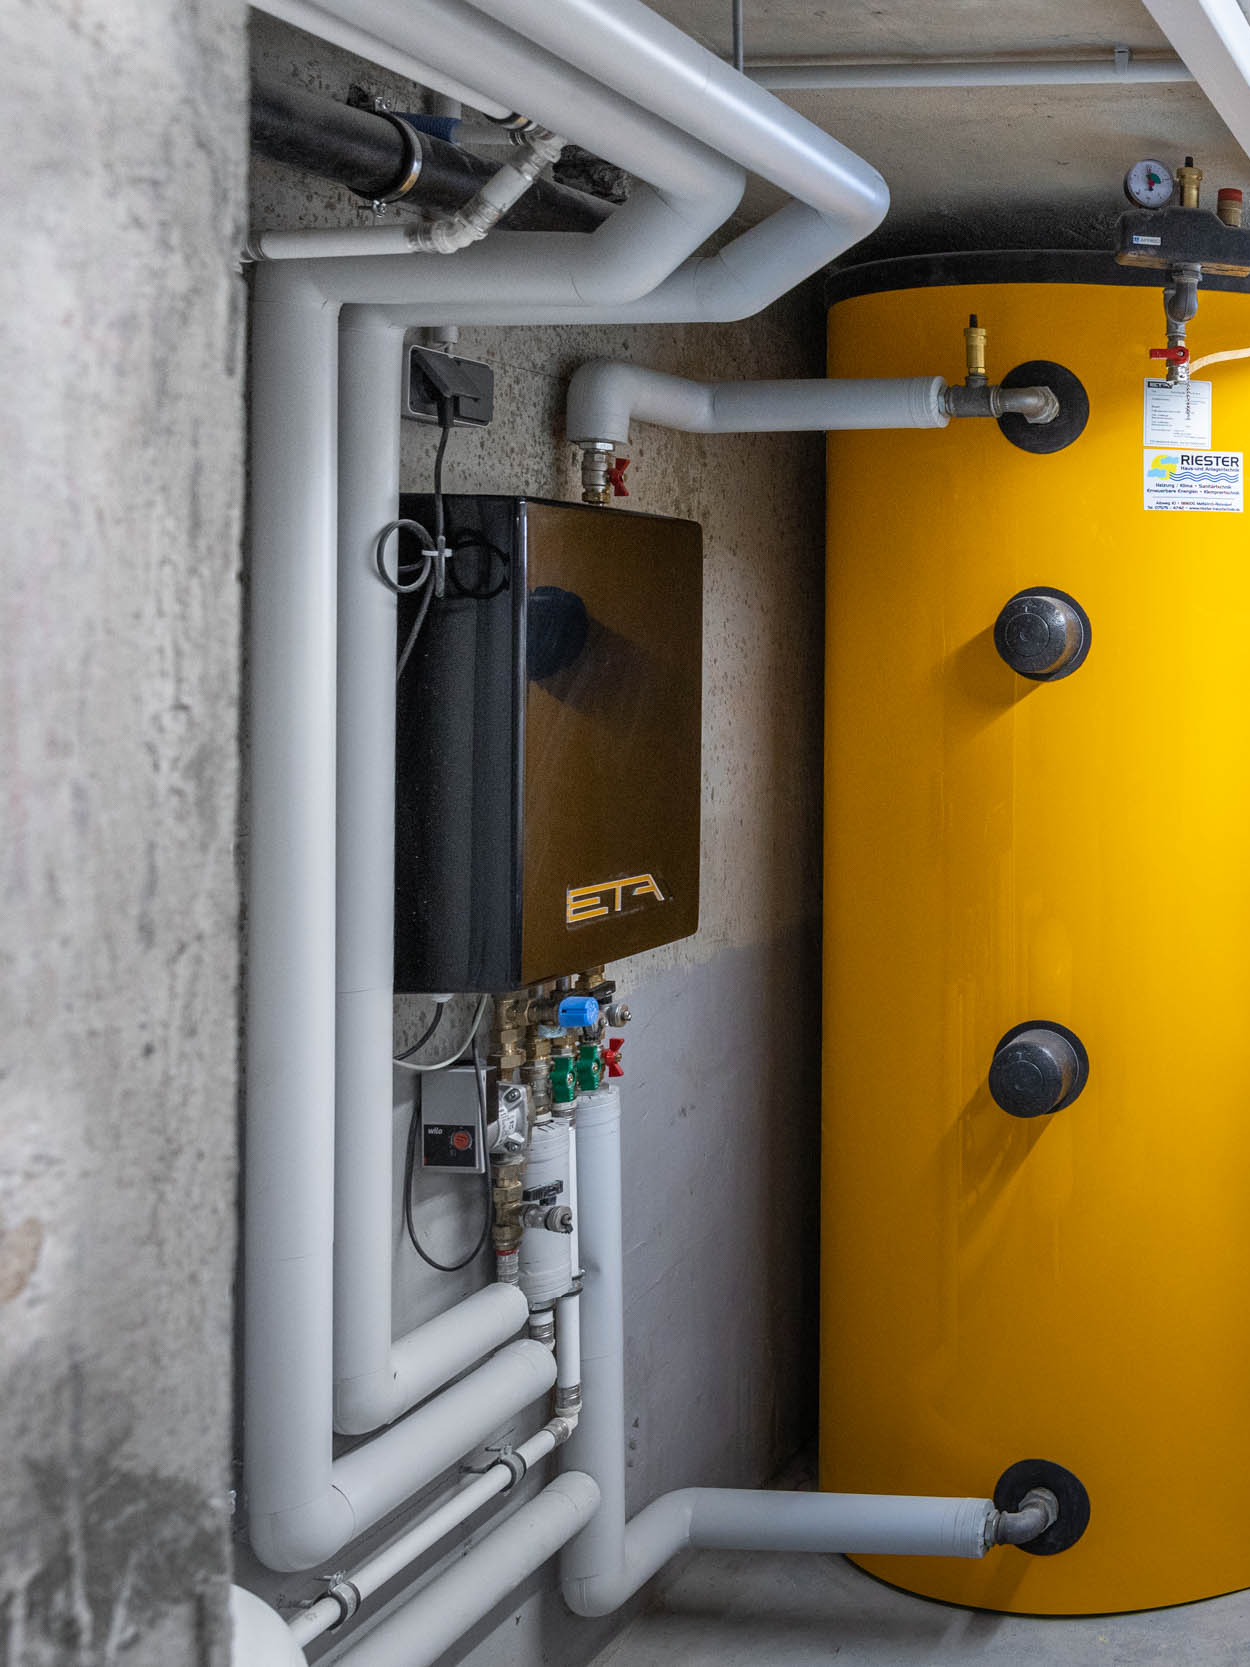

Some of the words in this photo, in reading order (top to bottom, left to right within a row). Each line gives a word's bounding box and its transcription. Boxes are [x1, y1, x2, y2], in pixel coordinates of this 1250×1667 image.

[1180, 454, 1239, 467] RIESTER
[566, 873, 665, 924] ETA
[428, 1127, 443, 1135] wilo
